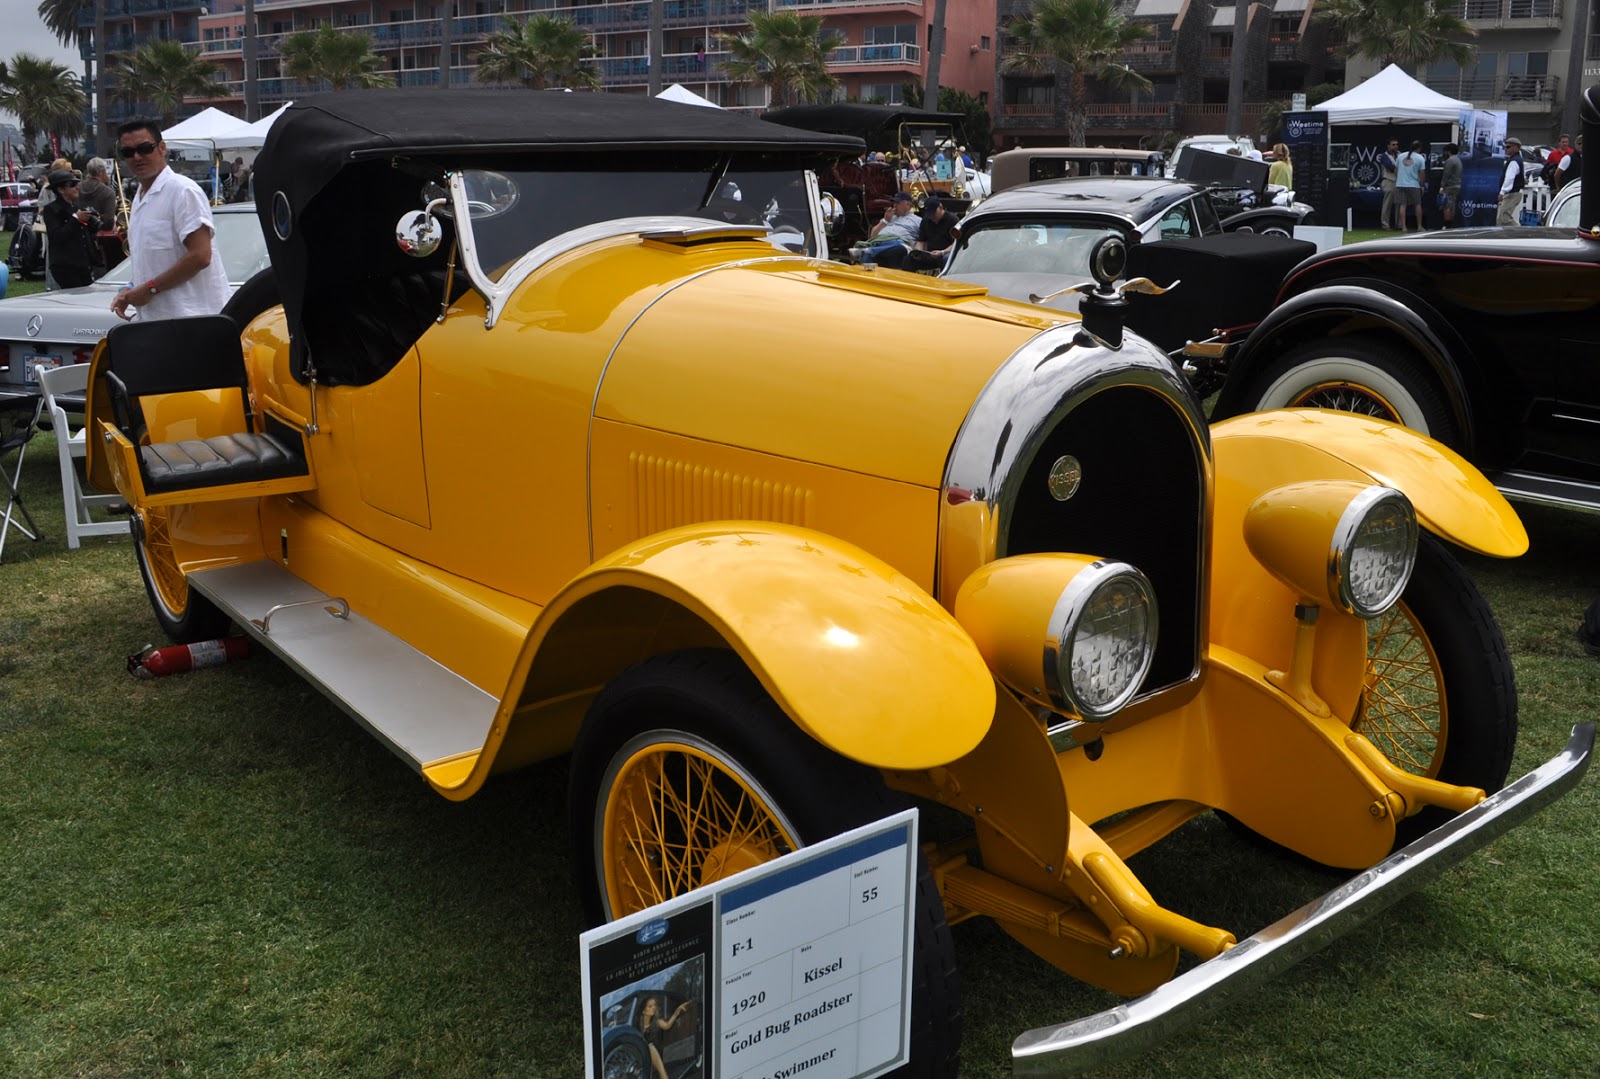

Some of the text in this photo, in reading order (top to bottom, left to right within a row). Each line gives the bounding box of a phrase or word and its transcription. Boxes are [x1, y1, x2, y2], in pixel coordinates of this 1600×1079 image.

[1290, 119, 1324, 128] Westime
[1463, 200, 1498, 209] Westime
[862, 886, 878, 904] 55
[732, 937, 754, 957] F-1
[804, 957, 843, 984] Kissel
[732, 991, 766, 1016] 1920
[731, 993, 853, 1054] Gold Bug Roadster
[774, 1048, 836, 1079] Swimmer
